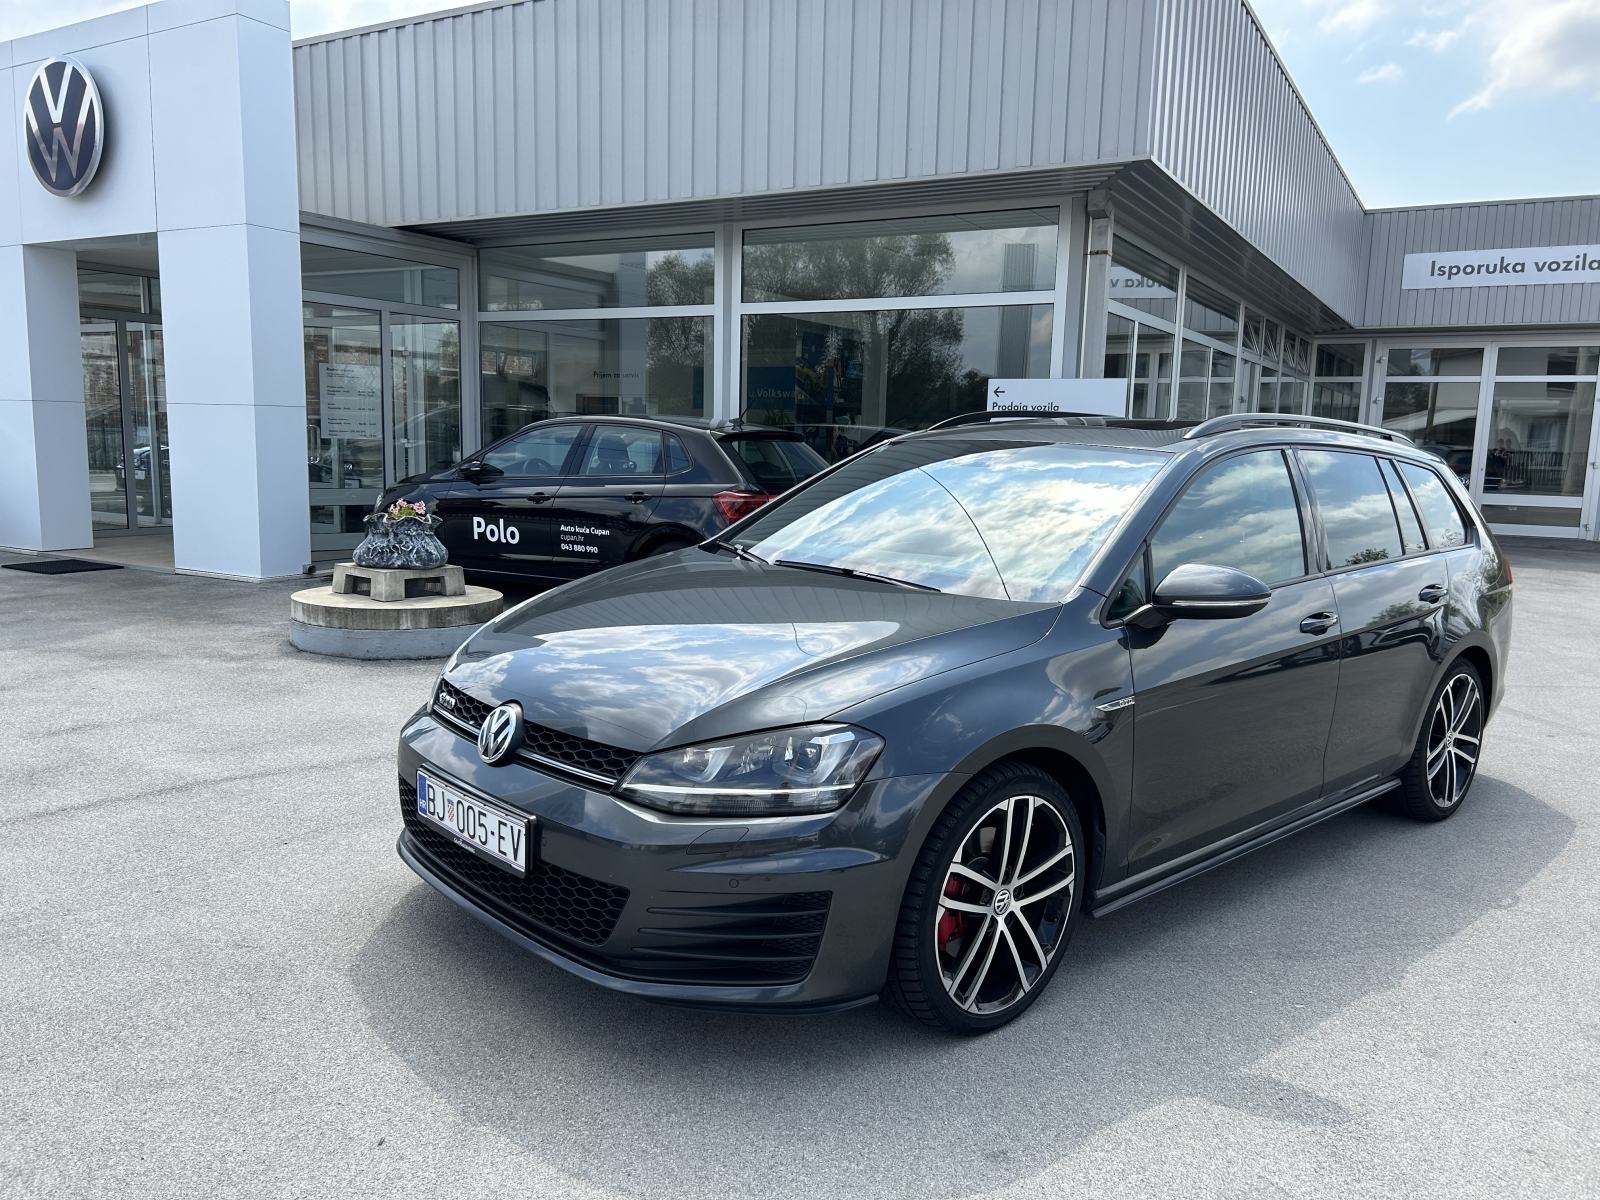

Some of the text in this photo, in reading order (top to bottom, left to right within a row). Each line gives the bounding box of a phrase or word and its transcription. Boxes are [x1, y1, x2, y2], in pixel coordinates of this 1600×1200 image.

[1430, 253, 1600, 280] Isporuka vozila
[1031, 402, 1060, 411] vozila
[472, 516, 520, 545] Polo
[560, 524, 610, 536] Auto kuća Cupan
[560, 543, 573, 551] 043
[574, 544, 585, 552] 880
[427, 783, 522, 862] BJ 005-EV
